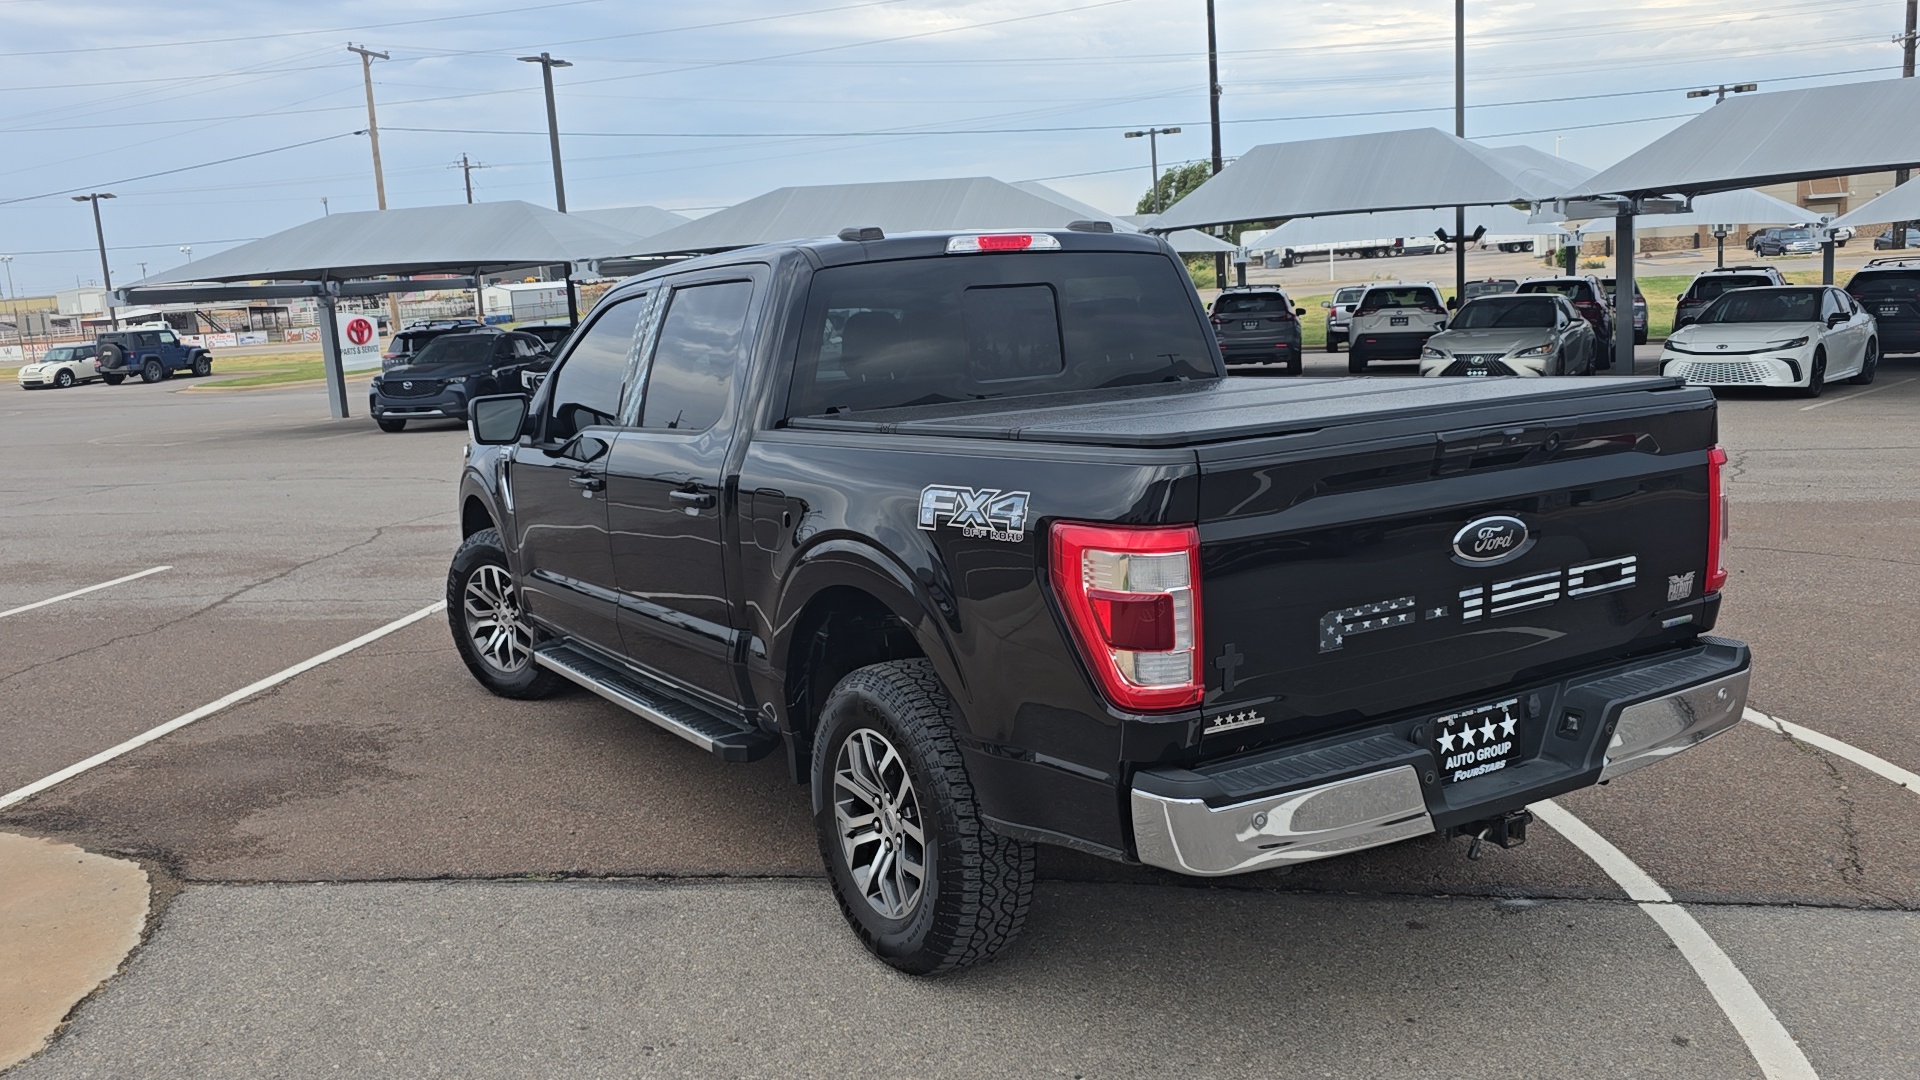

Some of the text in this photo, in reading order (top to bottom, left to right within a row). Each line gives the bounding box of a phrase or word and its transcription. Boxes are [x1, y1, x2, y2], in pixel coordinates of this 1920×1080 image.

[357, 347, 361, 355] &
[362, 345, 379, 354] SERVICE
[917, 484, 1030, 533] FX4
[963, 527, 1024, 542] OFF ROAD
[1474, 525, 1513, 552] Ford
[1318, 554, 1637, 653] F-150
[1445, 741, 1512, 770] AUTO GROUP
